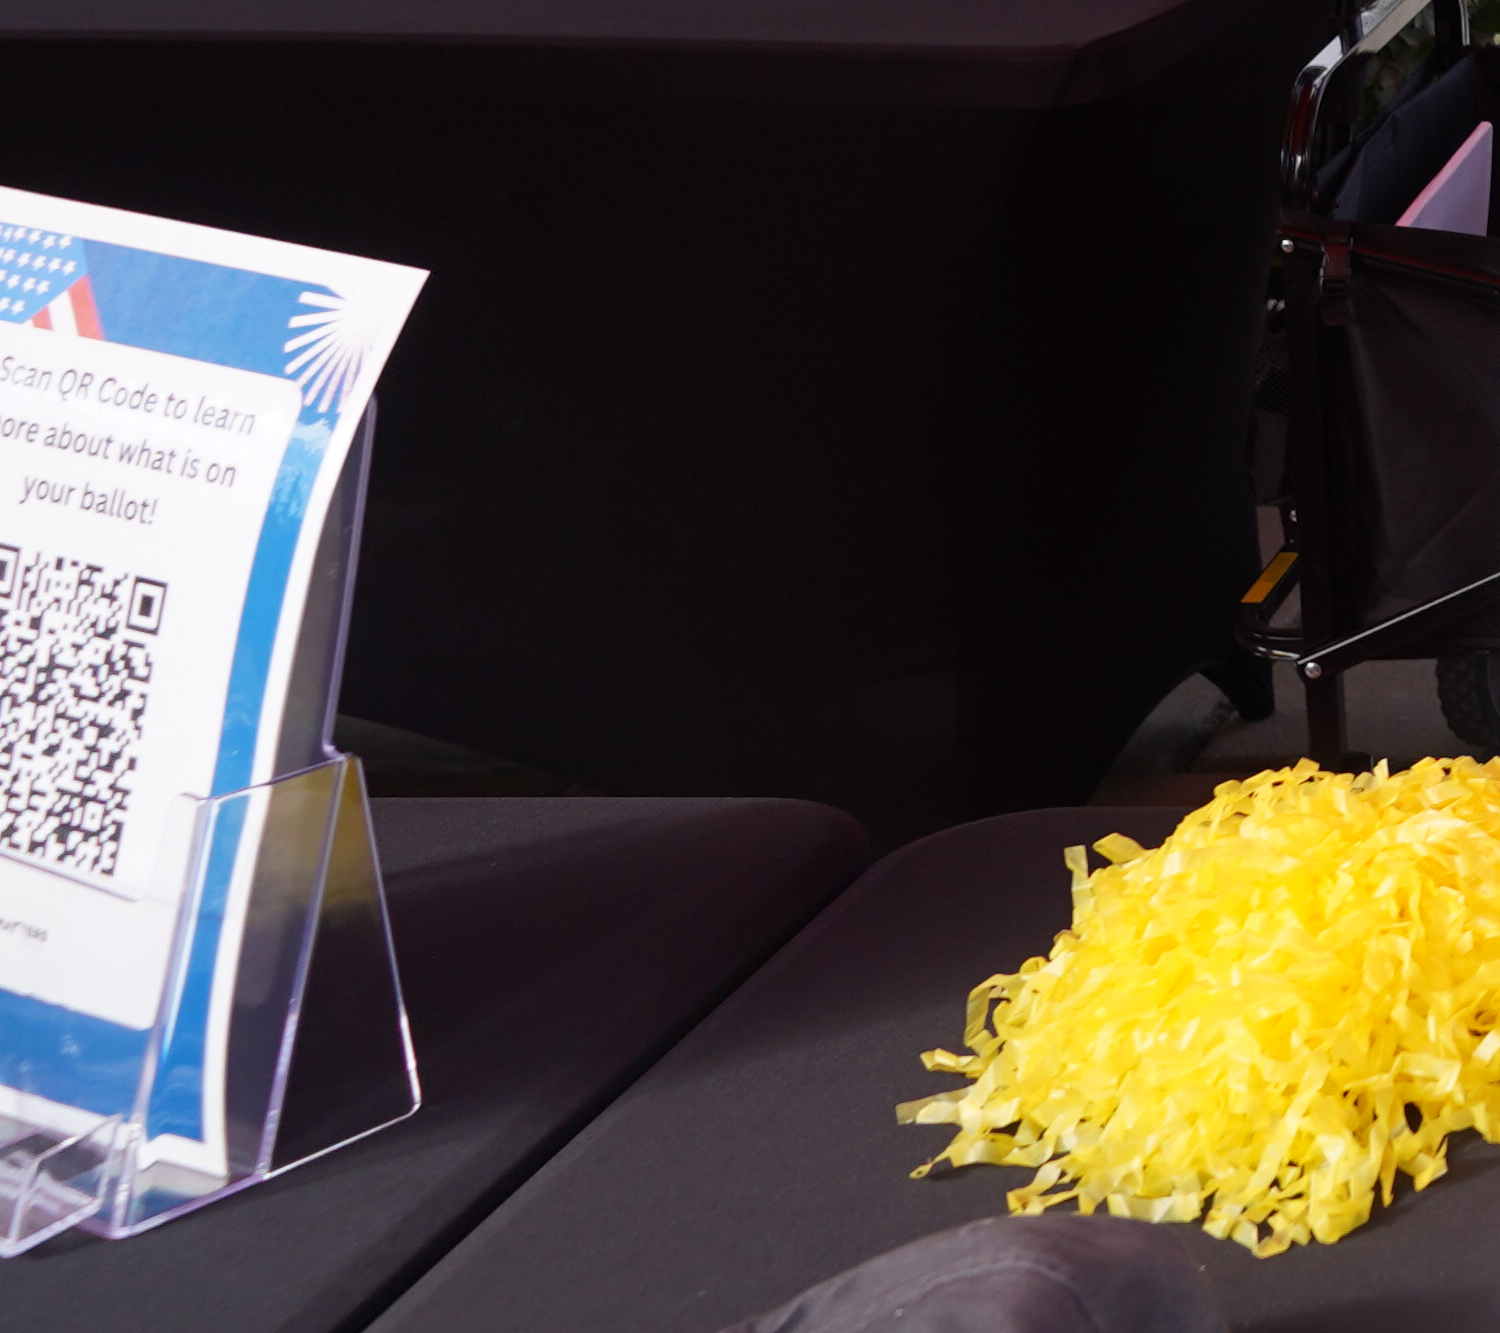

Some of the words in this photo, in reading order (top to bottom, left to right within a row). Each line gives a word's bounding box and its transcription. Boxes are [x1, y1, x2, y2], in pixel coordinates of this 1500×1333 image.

[0, 355, 52, 392] Scan
[58, 368, 95, 401] QR
[98, 376, 159, 414] Code
[164, 393, 189, 420] to
[193, 395, 257, 435] learn
[0, 415, 40, 443] ore
[43, 422, 115, 460] about
[118, 438, 177, 474] what
[180, 448, 202, 479] is
[205, 462, 238, 488] on
[18, 475, 76, 506] your
[79, 482, 159, 526] ballot!
